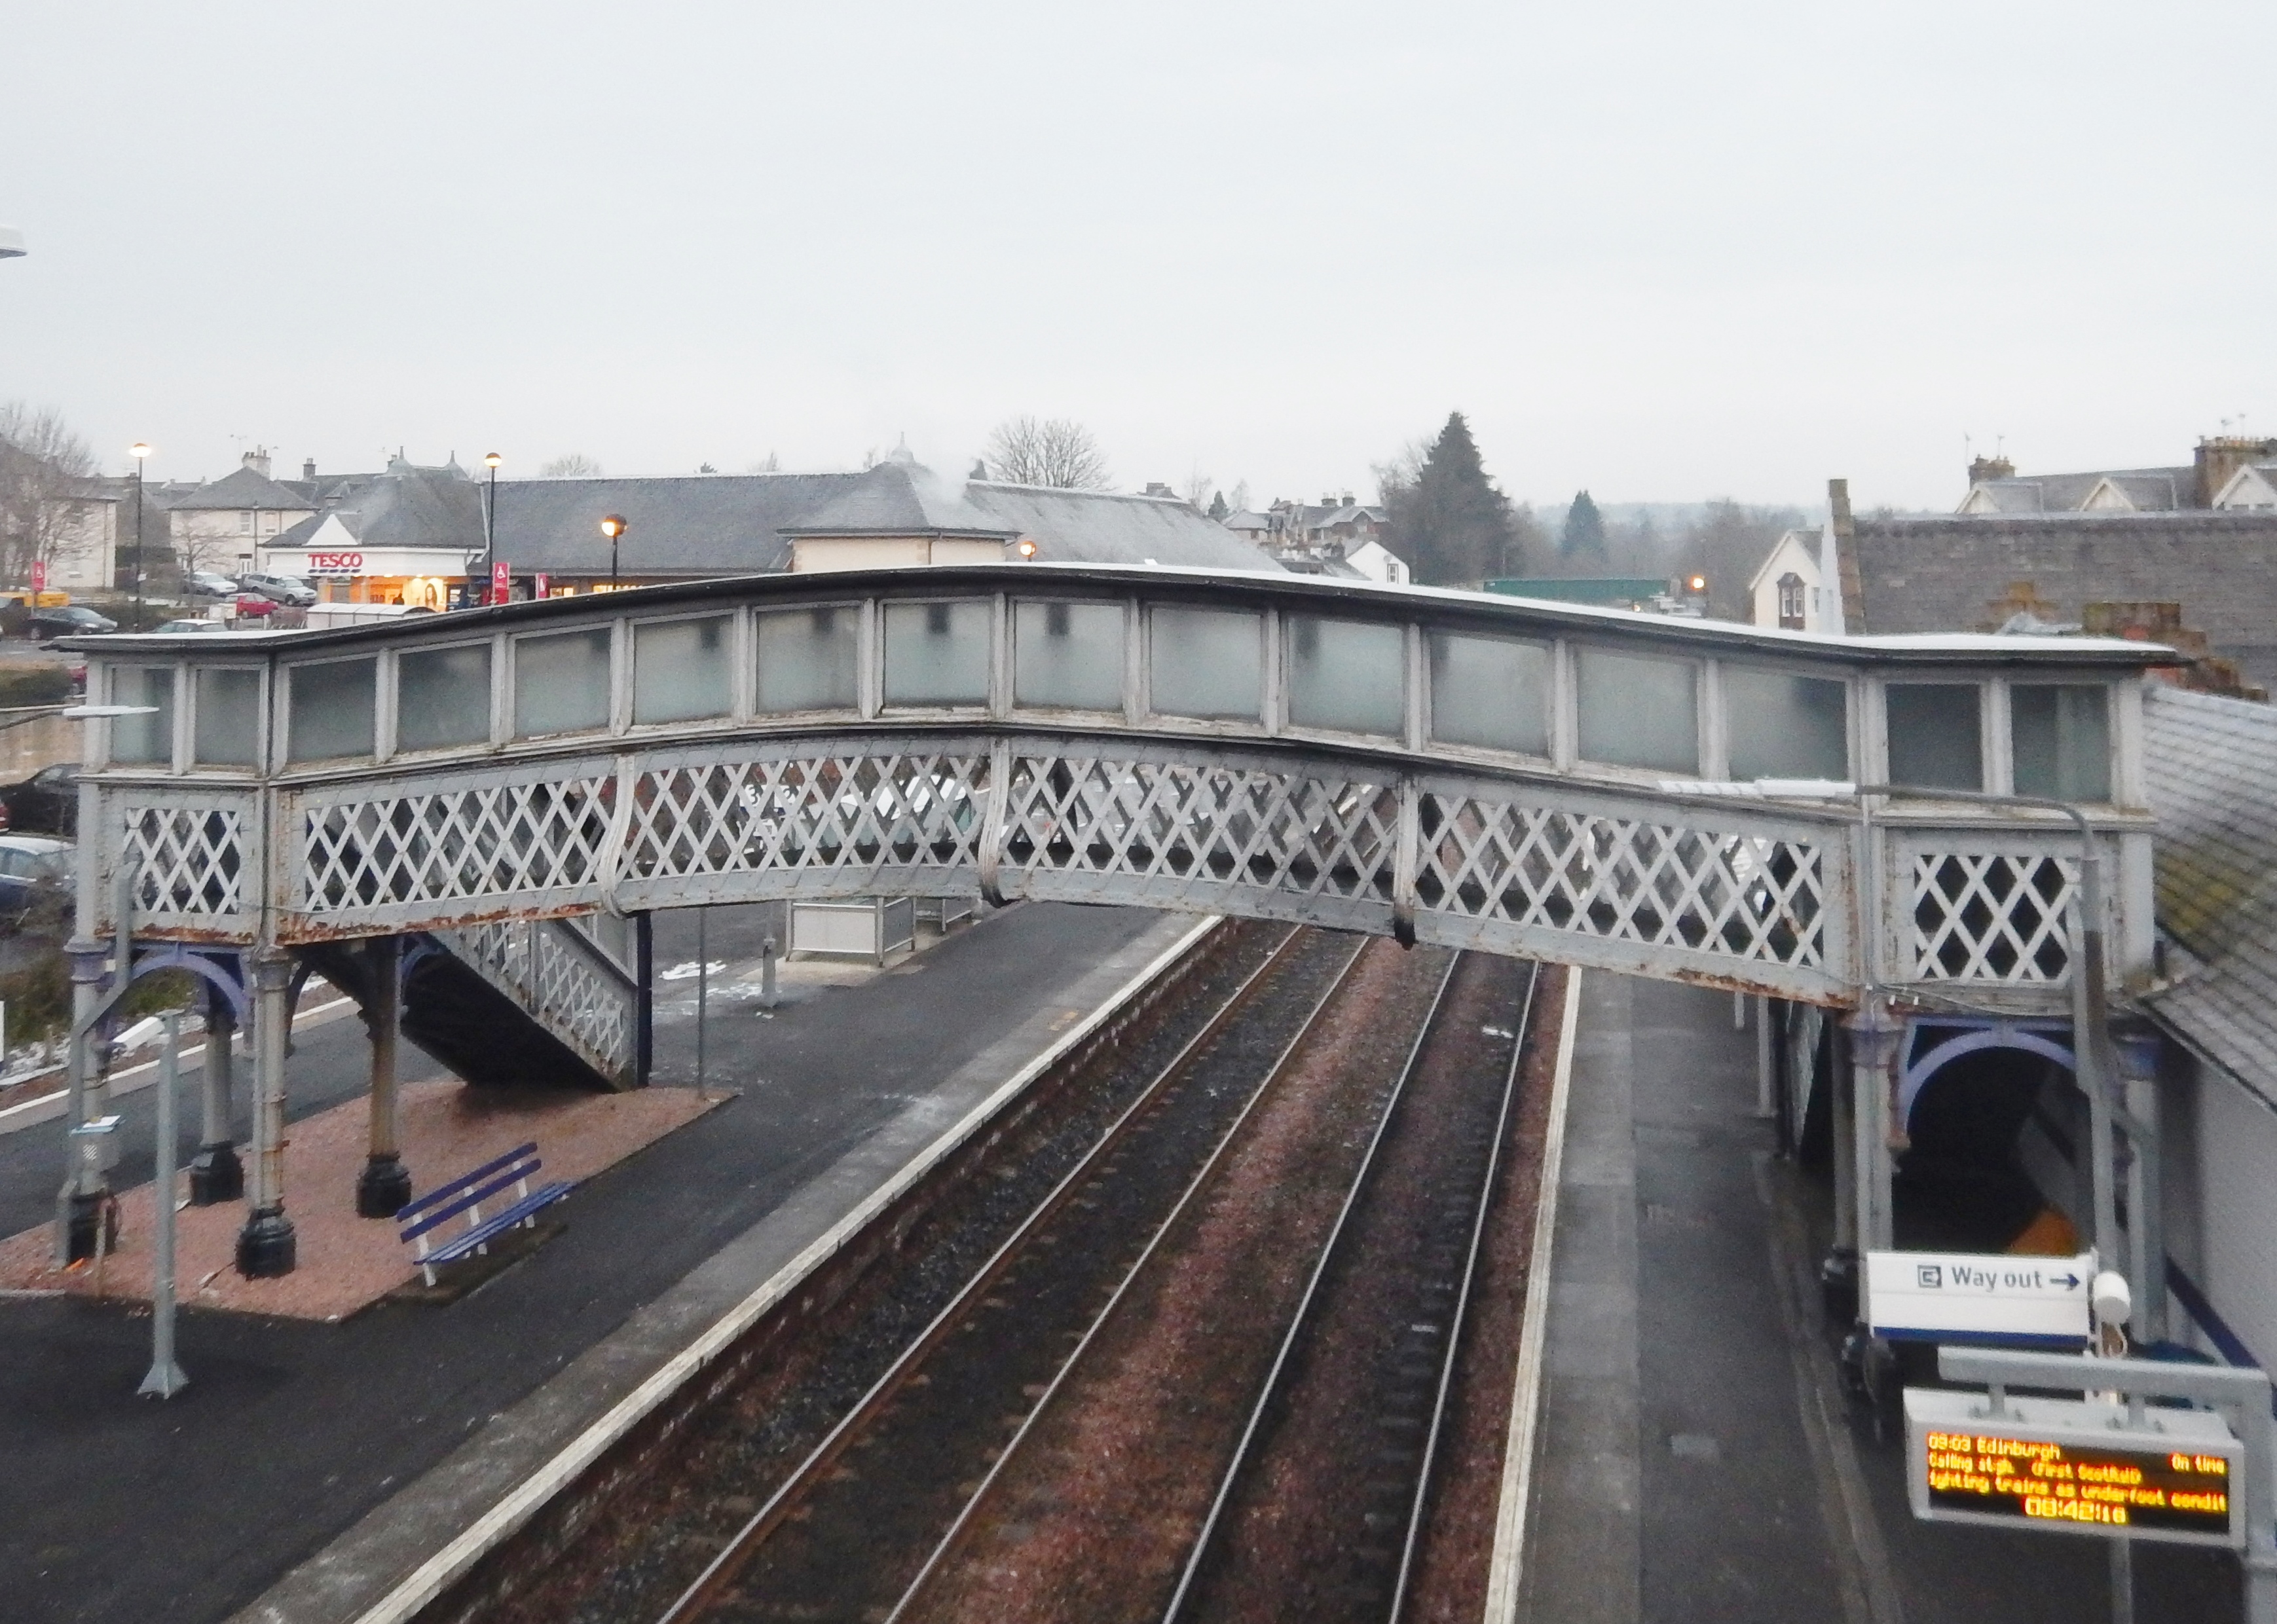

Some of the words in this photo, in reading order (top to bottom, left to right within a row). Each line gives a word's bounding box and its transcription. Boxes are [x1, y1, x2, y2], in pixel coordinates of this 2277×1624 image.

[307, 552, 363, 568] TESCO
[1952, 1266, 1997, 1293] Way
[2004, 1270, 2042, 1289] out
[1929, 1452, 1972, 1473] Calling
[1977, 1436, 2060, 1460] Edinburgh
[2172, 1453, 2190, 1471] On
[2195, 1455, 2225, 1474] time
[1995, 1476, 2048, 1494] trains
[2056, 1483, 2075, 1497] as
